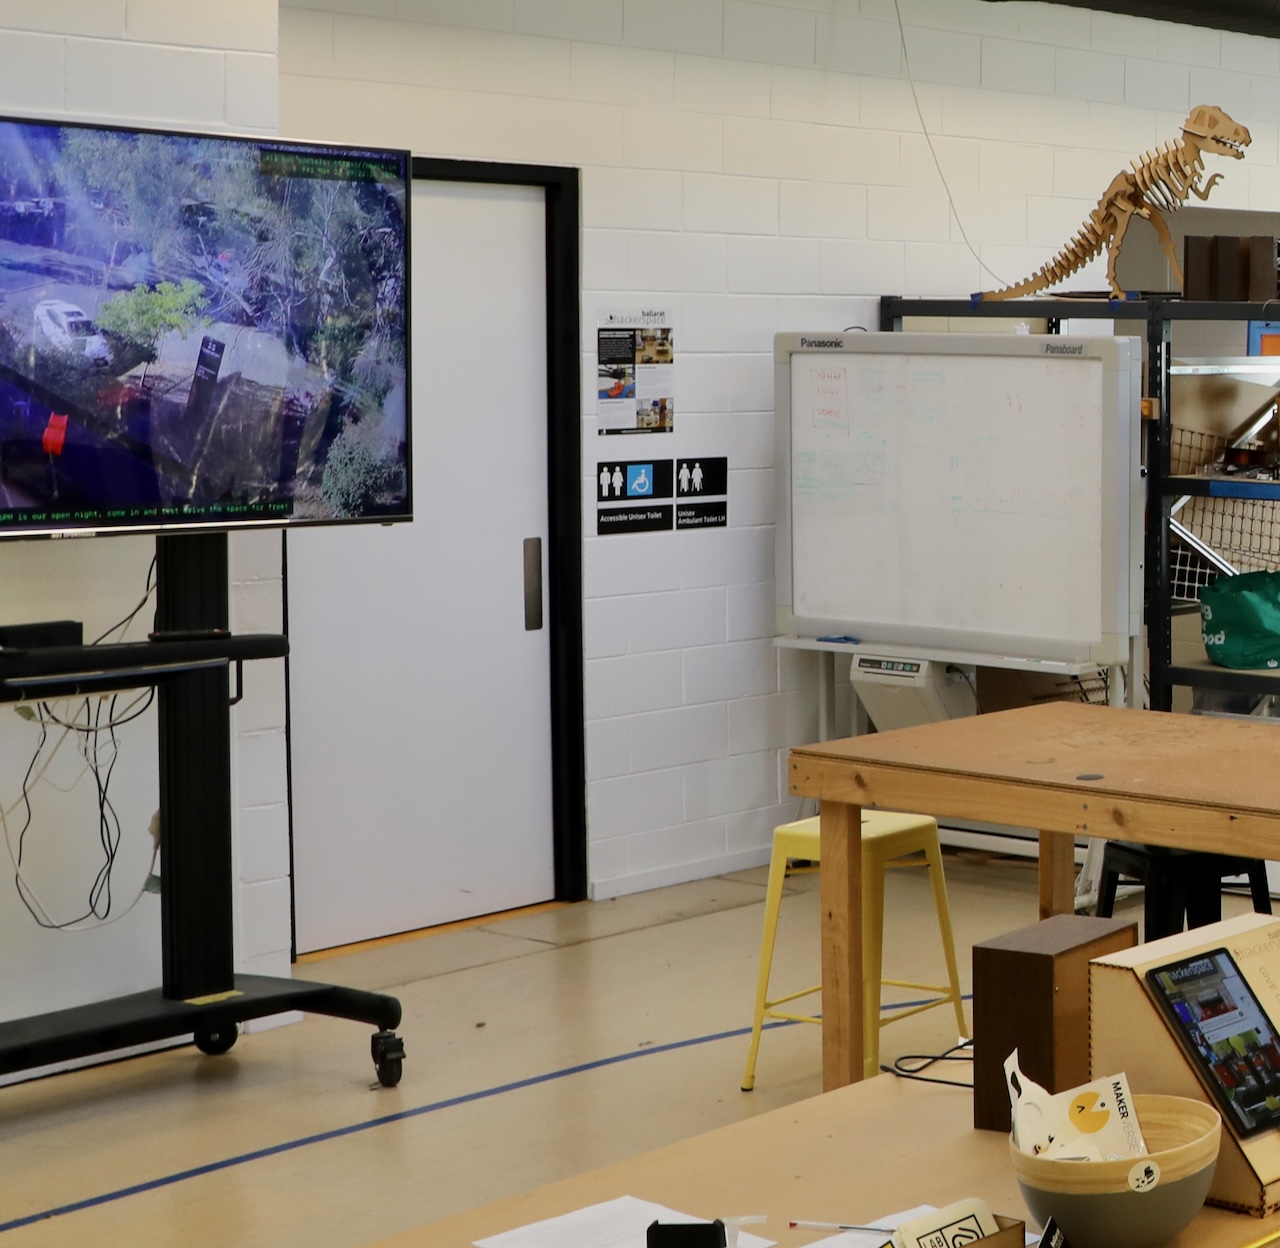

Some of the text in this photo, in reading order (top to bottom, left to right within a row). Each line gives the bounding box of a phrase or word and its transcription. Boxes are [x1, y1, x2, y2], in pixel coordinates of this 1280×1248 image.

[613, 314, 666, 325] hackerspace
[800, 338, 844, 349] Panasonic
[1045, 344, 1083, 355] Panaboard
[18, 512, 28, 521] is
[31, 512, 46, 520] our
[51, 511, 71, 521] open
[75, 510, 102, 520] night,
[130, 508, 140, 516] in
[161, 506, 179, 514] test
[183, 504, 205, 514] drive
[209, 505, 223, 513] the
[226, 505, 248, 513] space
[252, 503, 264, 512] for
[268, 502, 289, 511] free!
[600, 511, 662, 523] Accessible Unisex Toilet
[678, 516, 703, 525] Ambulant
[704, 515, 718, 523] Toilet
[1259, 966, 1278, 993] GIVE
